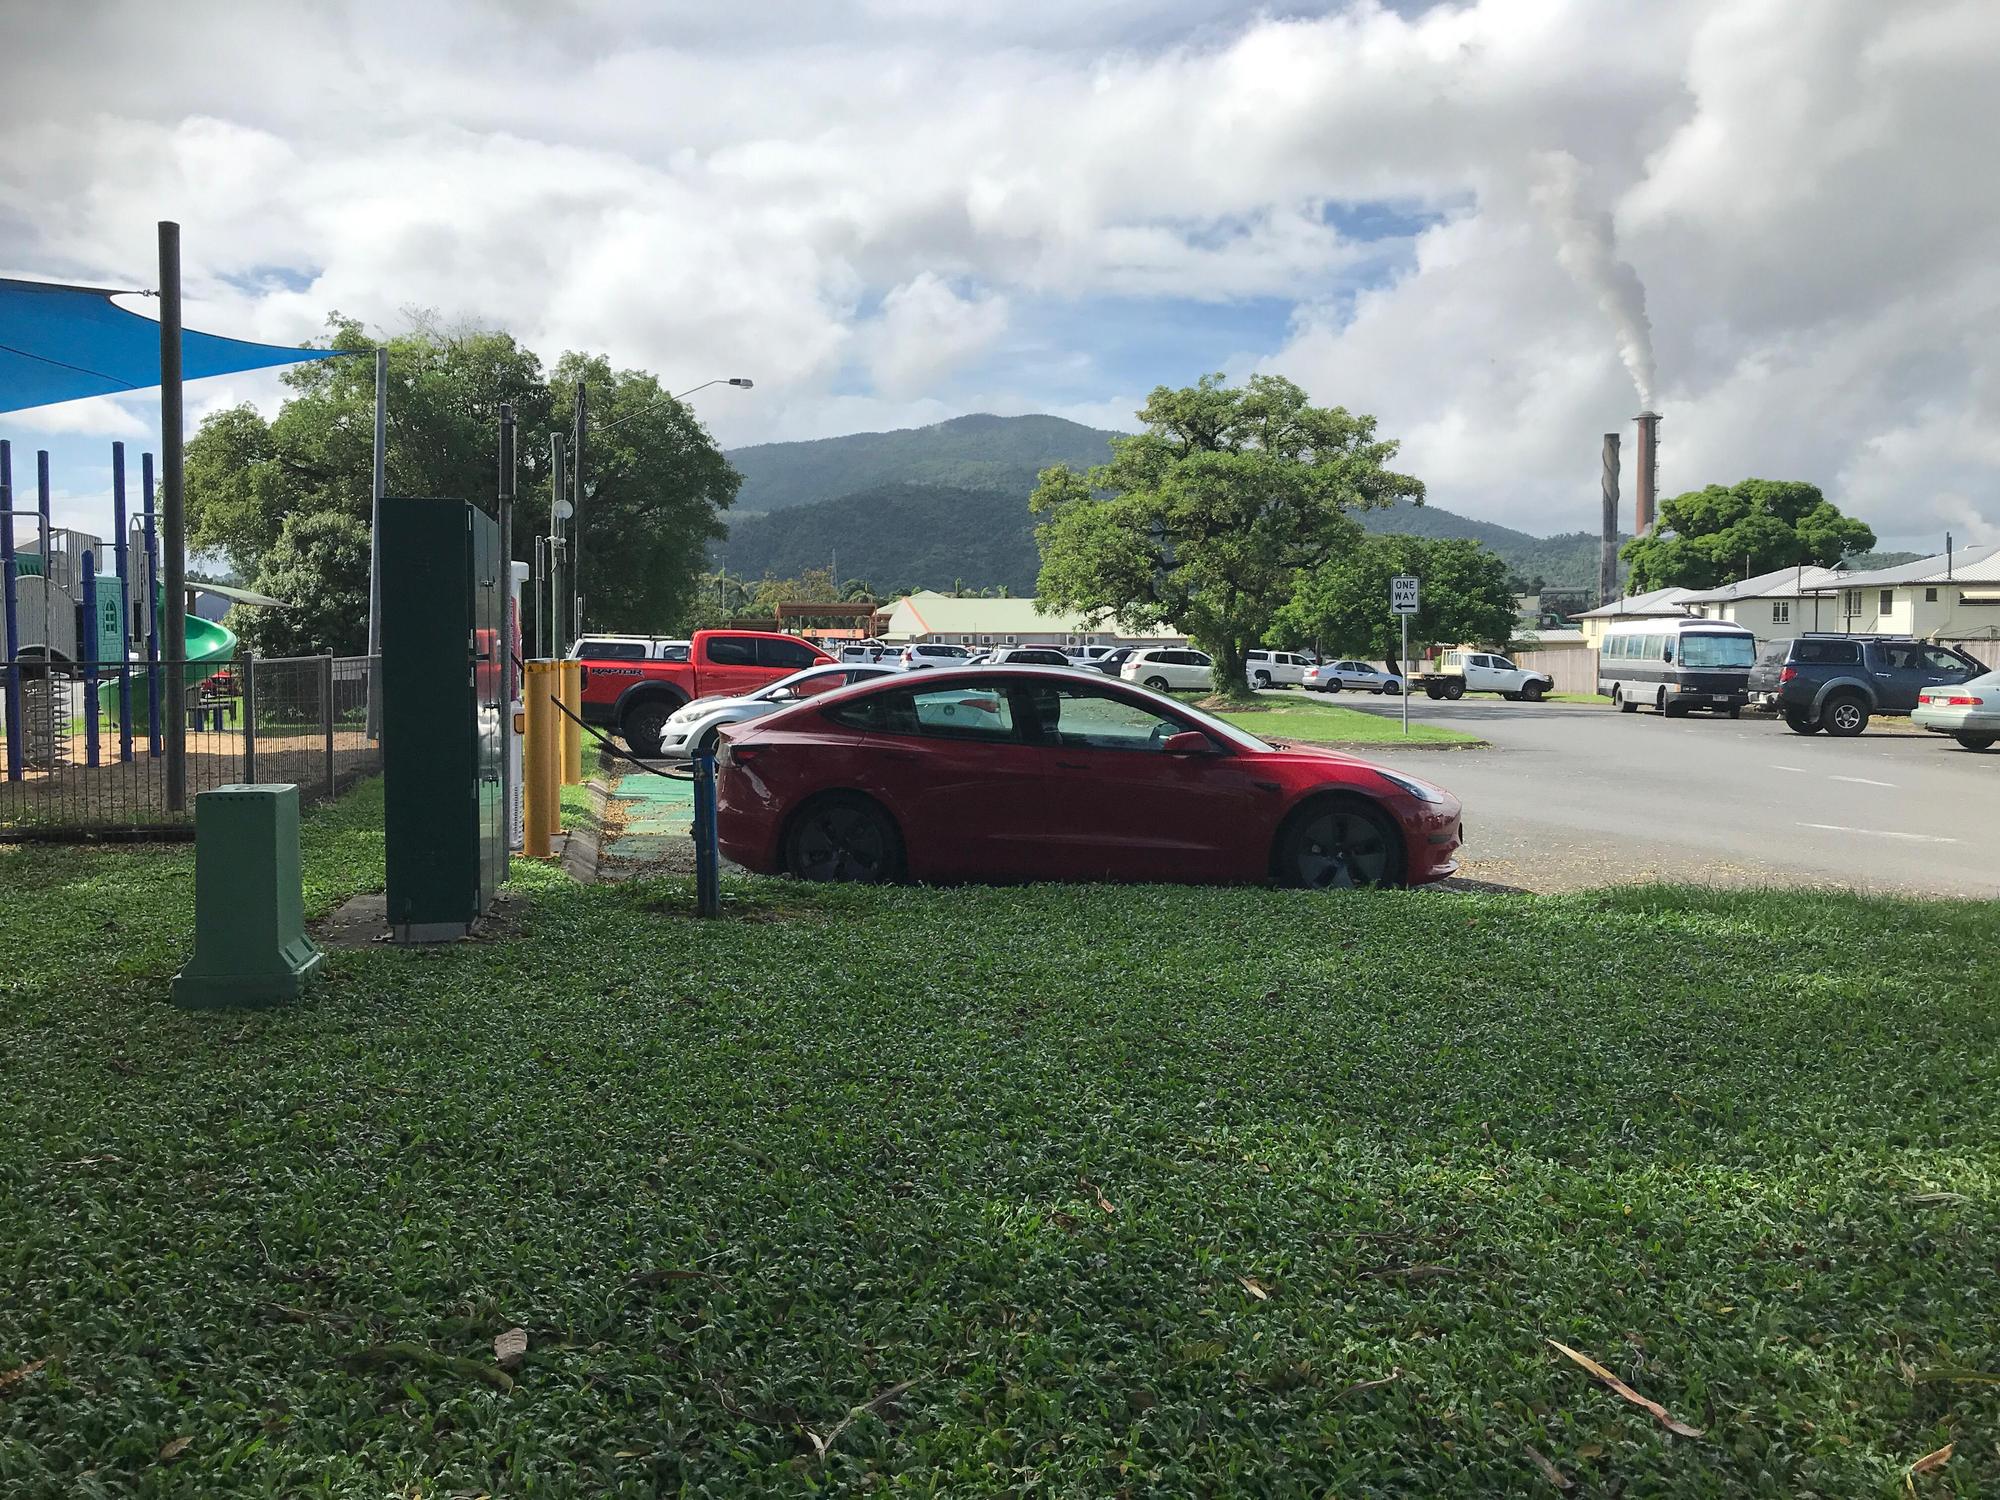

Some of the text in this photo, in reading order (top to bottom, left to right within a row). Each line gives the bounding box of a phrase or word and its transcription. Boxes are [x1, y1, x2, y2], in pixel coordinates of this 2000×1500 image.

[1395, 580, 1415, 589] ONE
[1394, 591, 1416, 600] WAY
[591, 668, 643, 676] RAPTOR
